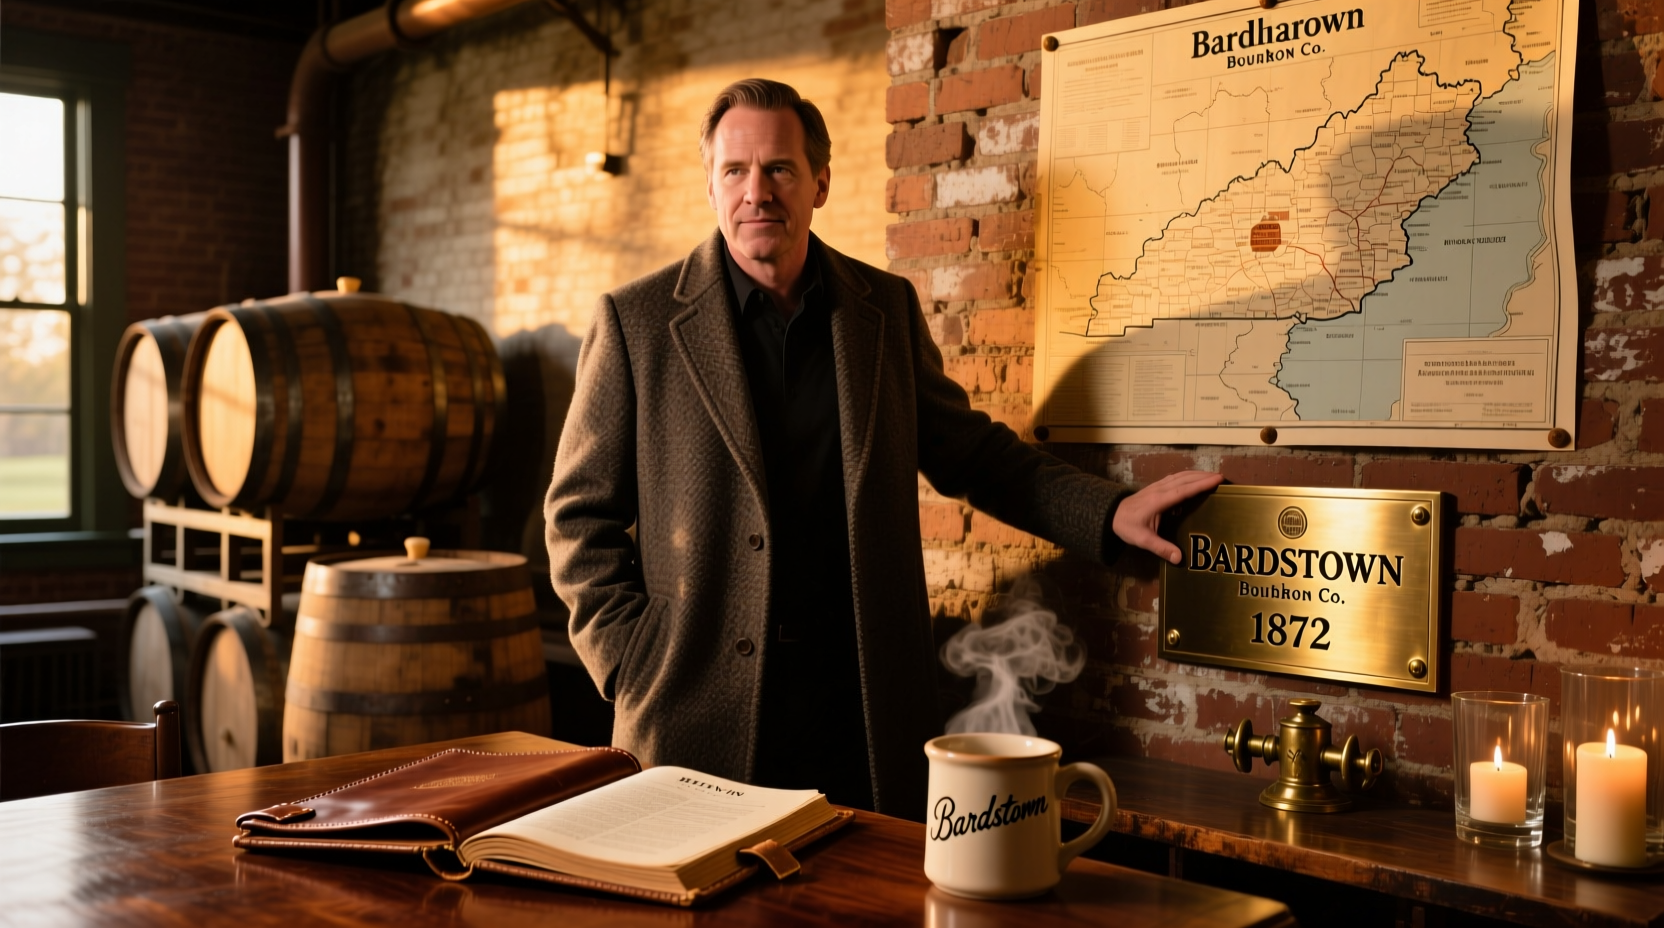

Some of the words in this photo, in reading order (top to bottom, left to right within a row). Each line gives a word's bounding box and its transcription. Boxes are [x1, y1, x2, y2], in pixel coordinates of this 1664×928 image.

[1189, 533, 1405, 587] BARDSTOWN
[1318, 587, 1346, 605] Co.
[1250, 611, 1331, 651] 1872
[930, 794, 1049, 842] Bardstown
